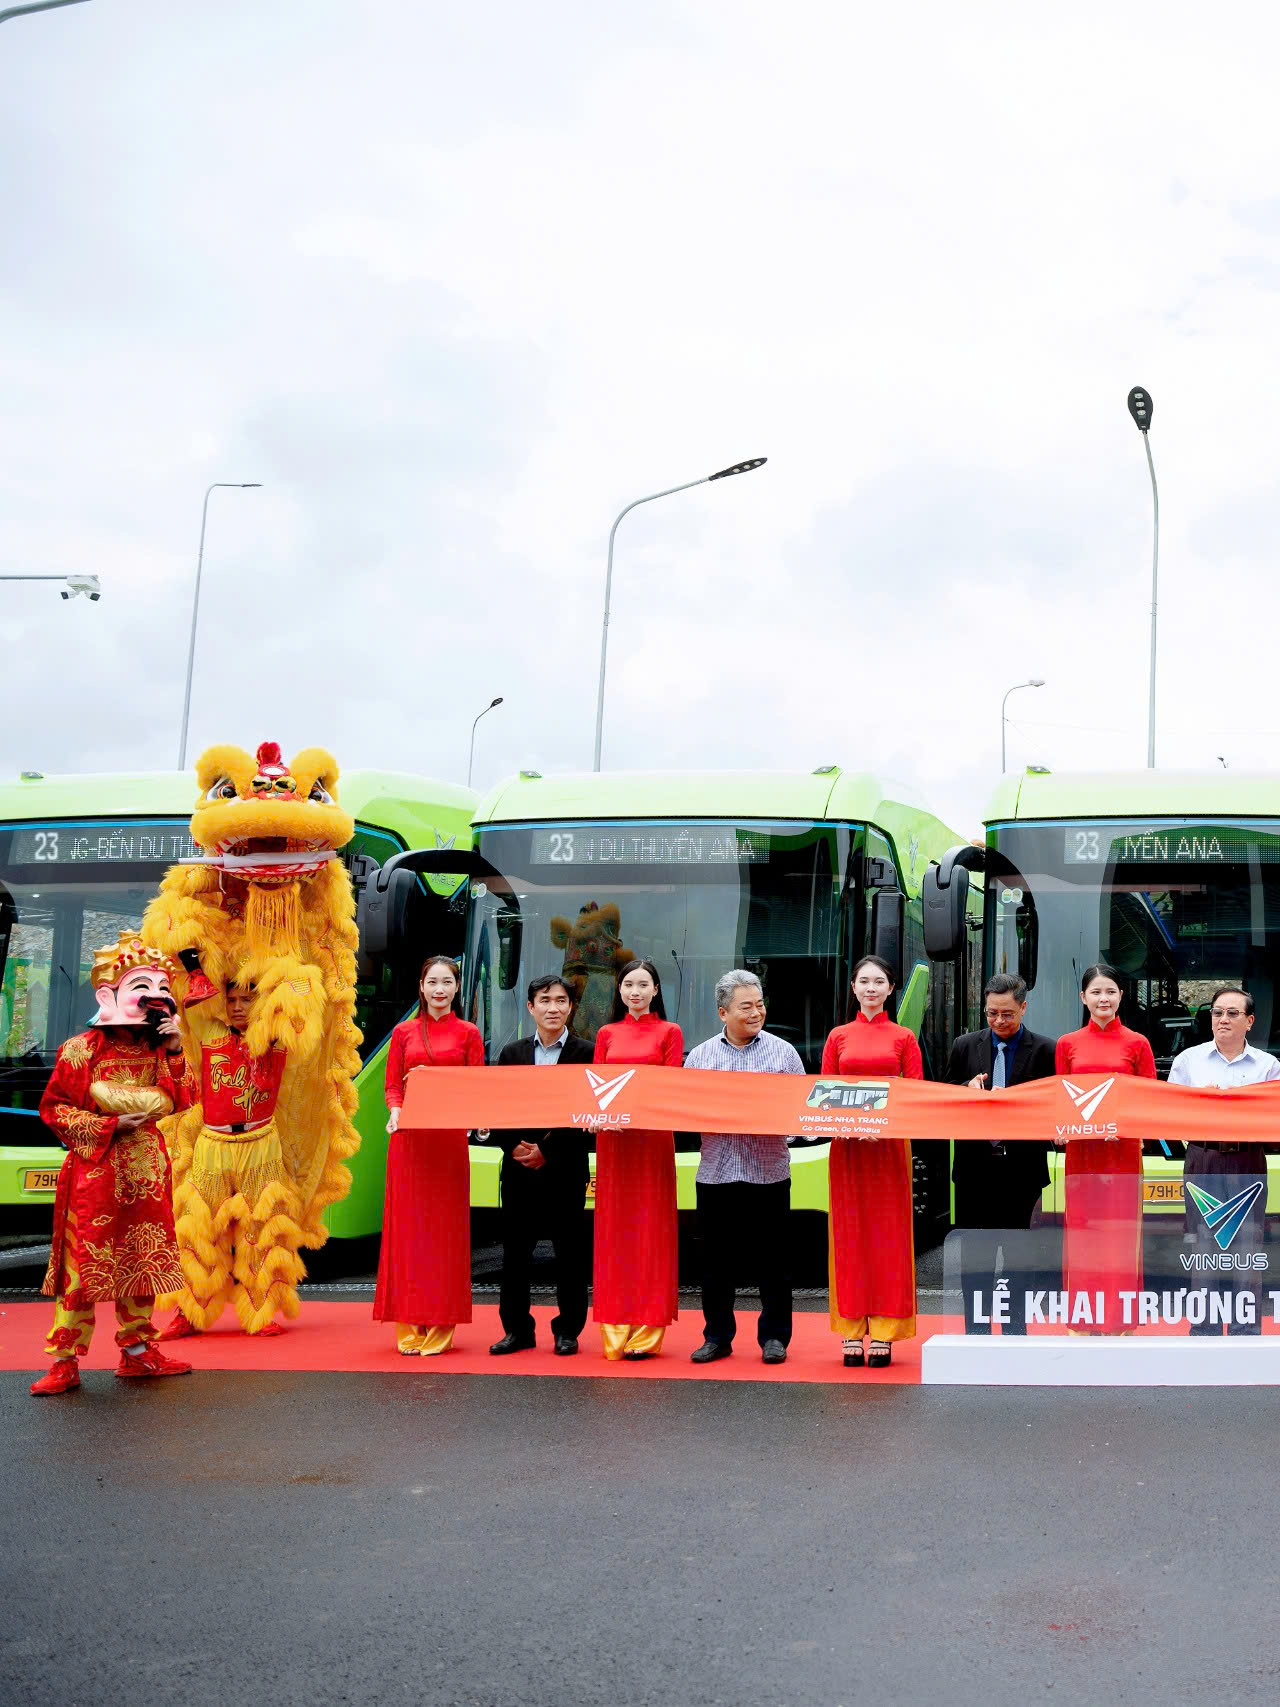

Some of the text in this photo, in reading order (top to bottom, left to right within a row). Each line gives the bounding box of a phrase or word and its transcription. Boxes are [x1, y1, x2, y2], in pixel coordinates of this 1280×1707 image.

[35, 832, 58, 860] 23
[139, 836, 163, 857] DU
[550, 834, 574, 861] 23
[600, 838, 624, 860] DU
[708, 838, 755, 860] ANA
[1075, 831, 1099, 860] 23
[1176, 836, 1223, 859] ANA
[572, 1113, 631, 1124] VINBUS
[799, 1115, 833, 1123] VINBUS
[857, 1117, 889, 1125] TRANG
[1055, 1123, 1118, 1135] VINBUS
[1180, 1253, 1269, 1271] VINBUS
[973, 1278, 1011, 1324] LỄ
[1025, 1290, 1105, 1324] KHAI
[1119, 1287, 1256, 1324] TRƯƠNG
